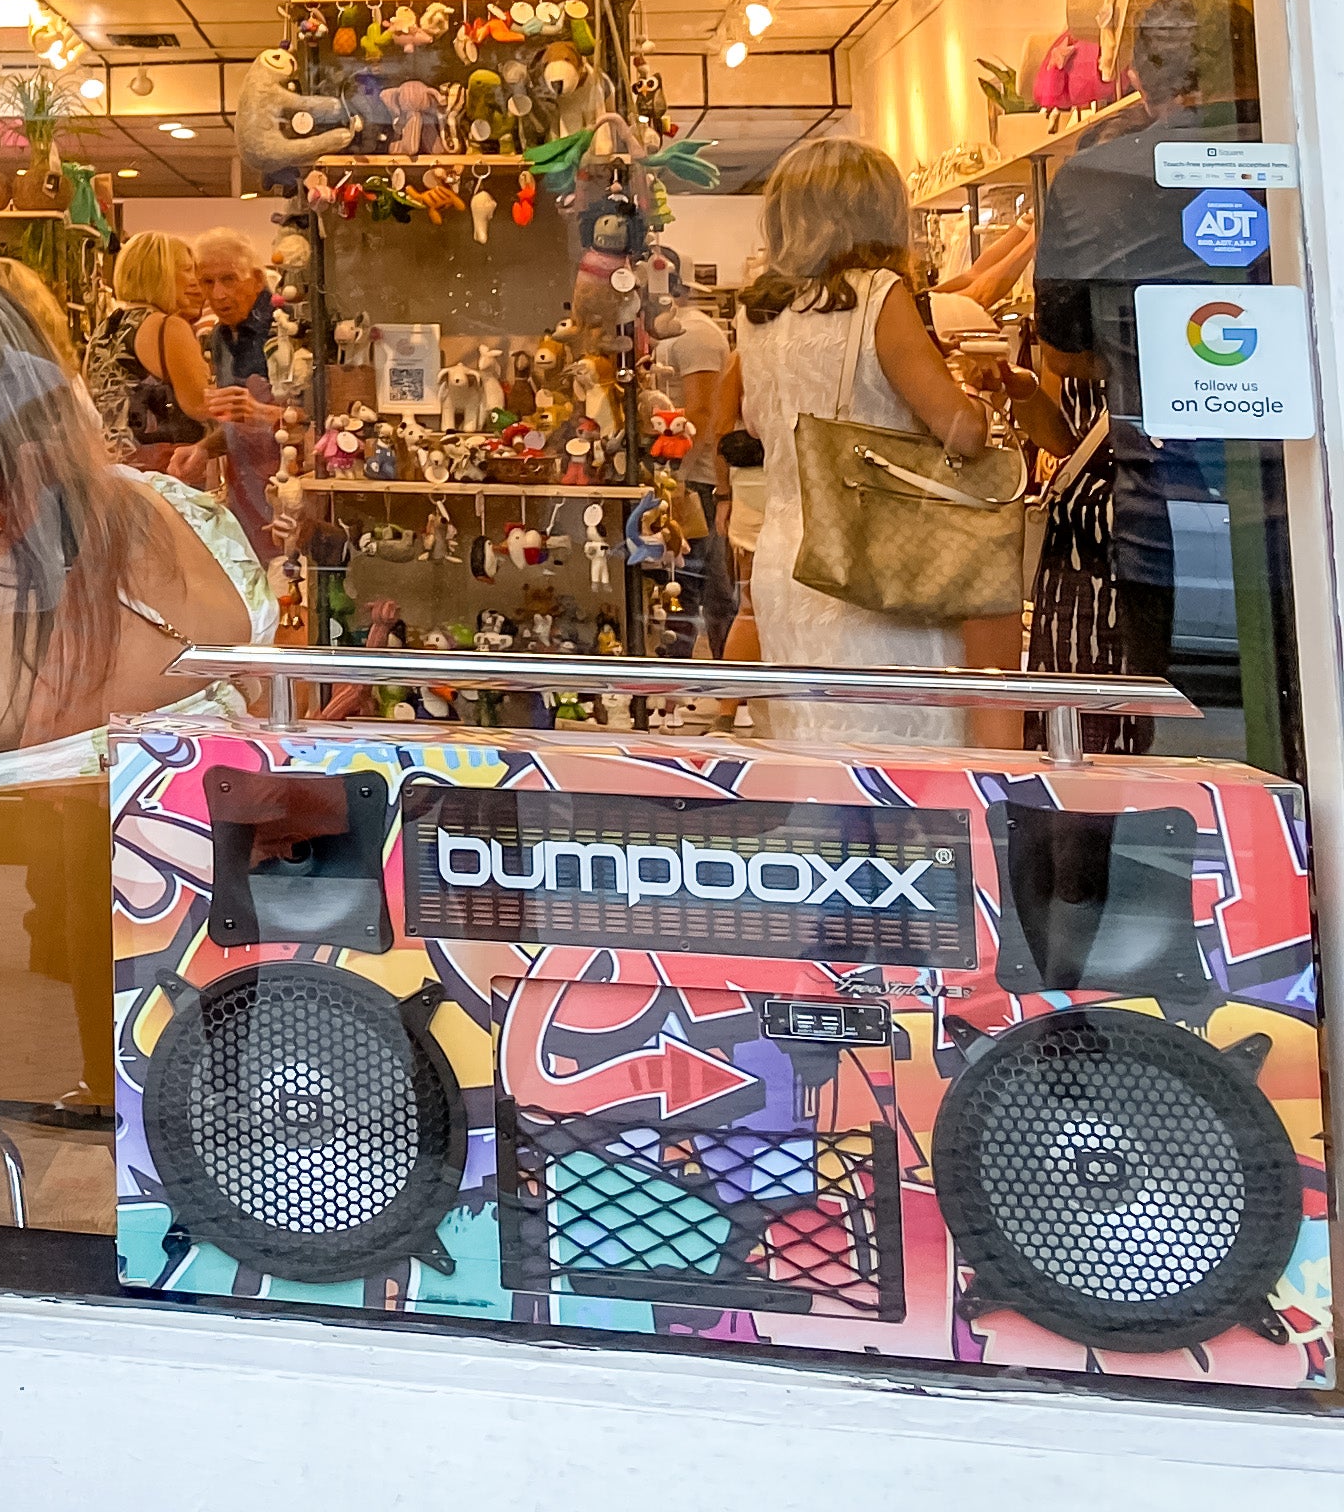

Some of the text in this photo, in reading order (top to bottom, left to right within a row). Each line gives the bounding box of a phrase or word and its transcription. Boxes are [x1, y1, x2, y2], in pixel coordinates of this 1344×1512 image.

[1195, 210, 1258, 238] ADT
[1194, 379, 1259, 392] follow us
[1171, 395, 1284, 418] on Google
[437, 826, 937, 912] bumpboxx
